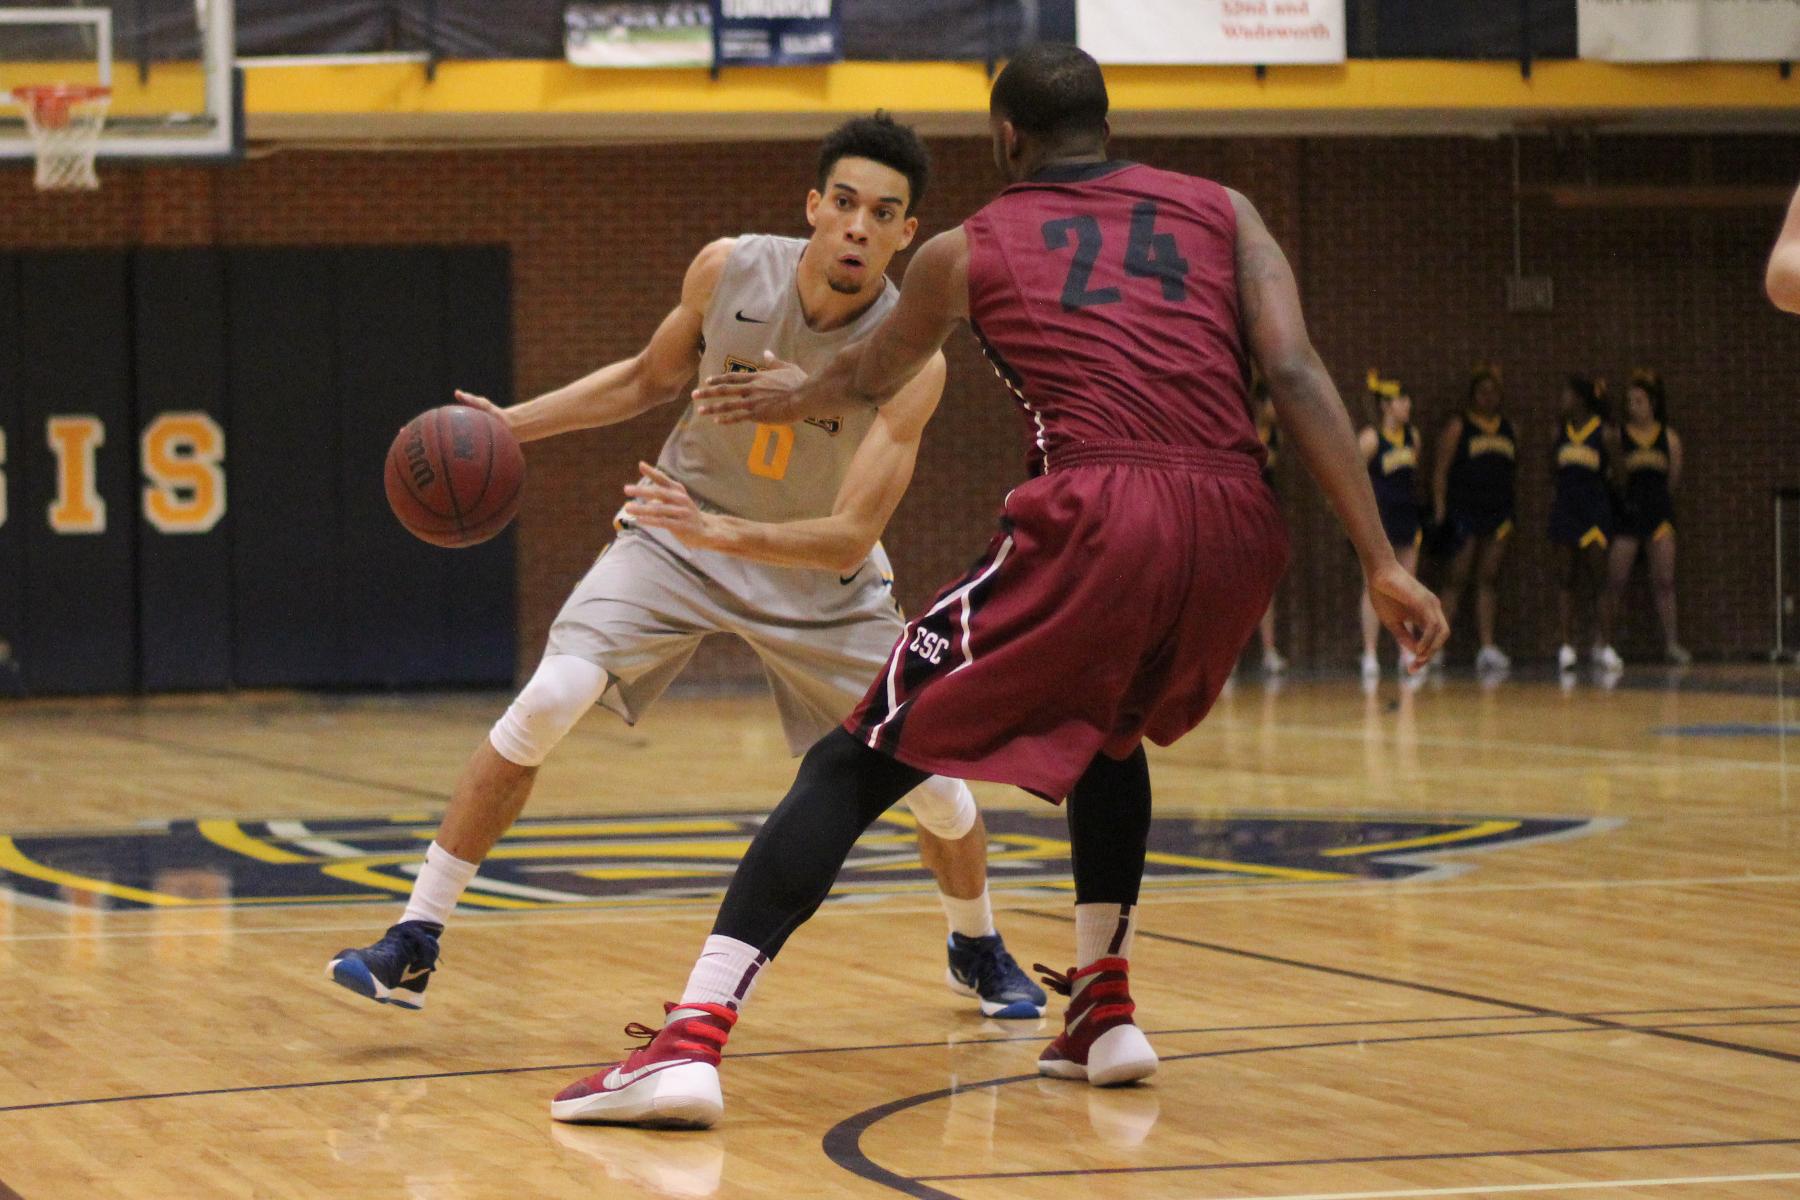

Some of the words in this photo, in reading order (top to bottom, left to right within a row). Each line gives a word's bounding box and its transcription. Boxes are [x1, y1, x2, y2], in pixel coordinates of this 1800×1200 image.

[1274, 0, 1310, 16] and
[1041, 201, 1189, 314] 24
[0, 411, 227, 534] IS
[747, 422, 795, 480] 0
[909, 626, 949, 665] CSC
